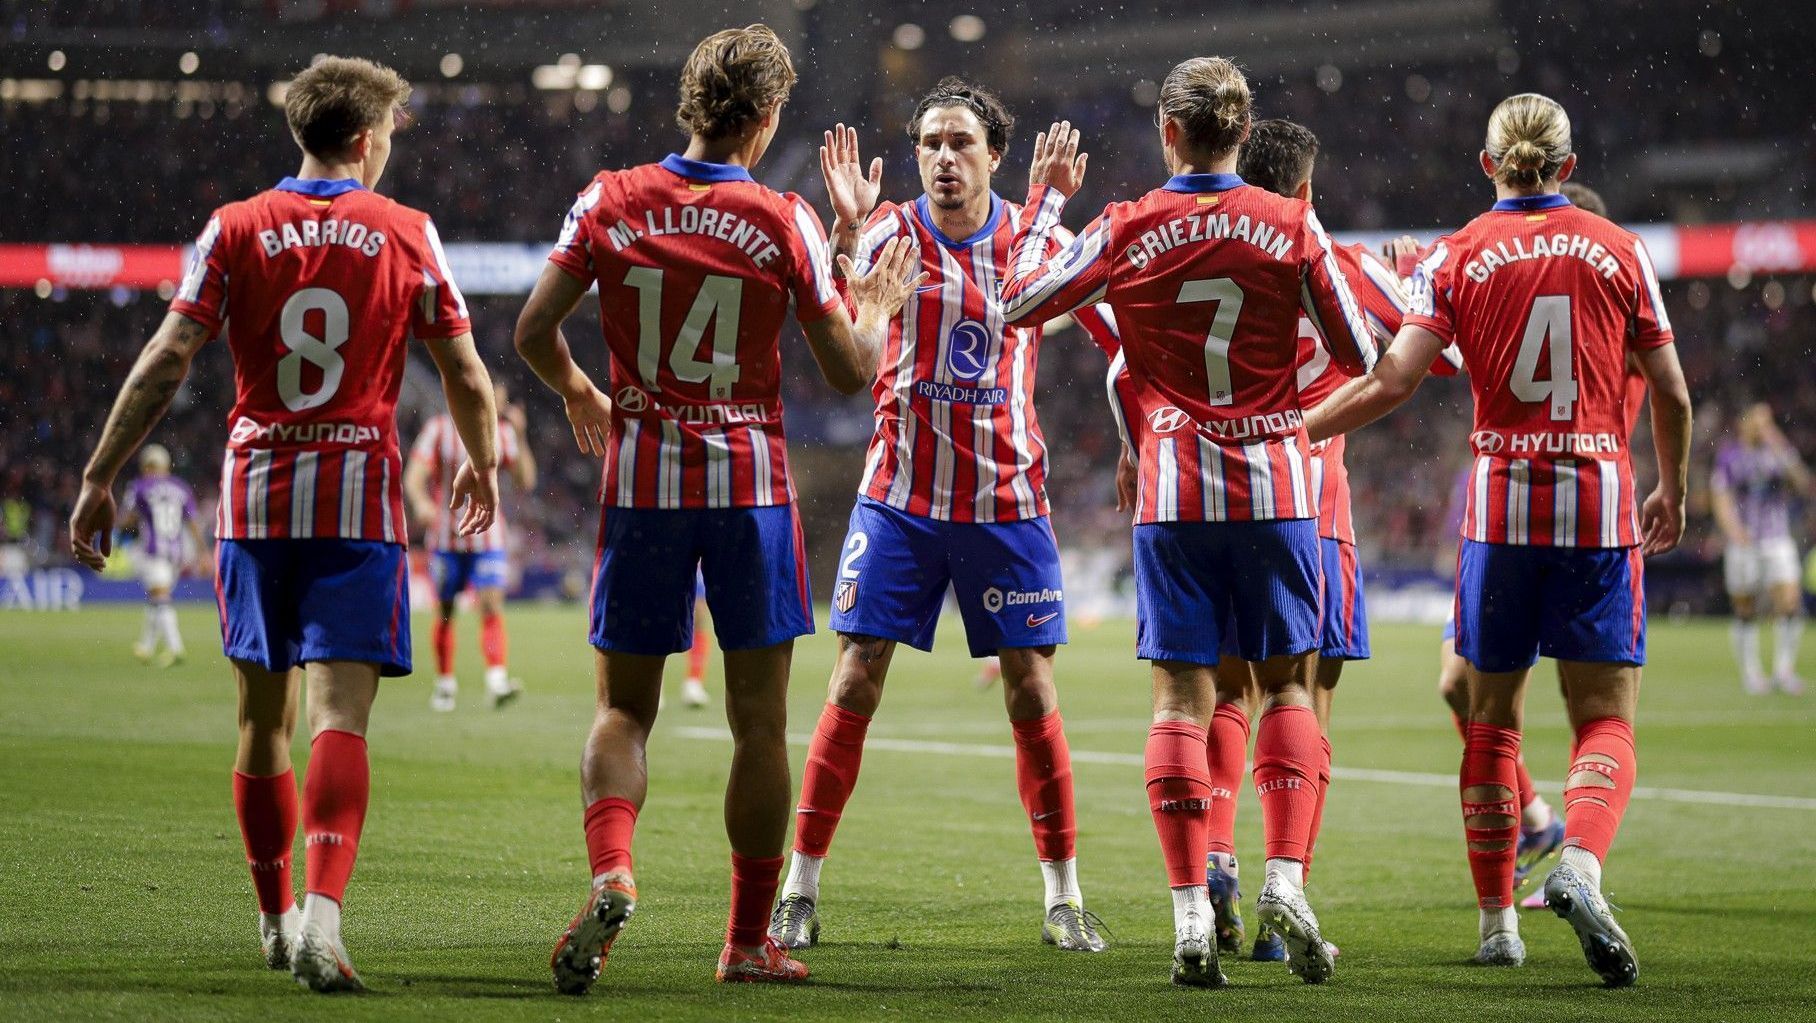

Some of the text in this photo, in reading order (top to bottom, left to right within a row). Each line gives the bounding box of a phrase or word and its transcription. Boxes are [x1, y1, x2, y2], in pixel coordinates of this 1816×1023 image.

[258, 218, 386, 258] BARRIOS
[606, 205, 781, 269] M. LLORENTE
[1126, 213, 1294, 270] GRIEZMANN
[1465, 233, 1620, 284] GALLAGHER
[276, 287, 350, 412] 8
[622, 265, 744, 402] 14
[1175, 277, 1245, 407] 7
[1509, 294, 1578, 421] 4
[919, 381, 1005, 403] RIYADH AIR
[1510, 432, 1619, 454] HYUNDAI
[841, 531, 869, 579] 2
[1006, 588, 1063, 606] ComAve
[1161, 797, 1212, 811] ATLETI
[1212, 787, 1232, 799] ETI
[1256, 776, 1302, 798] ATLETI
